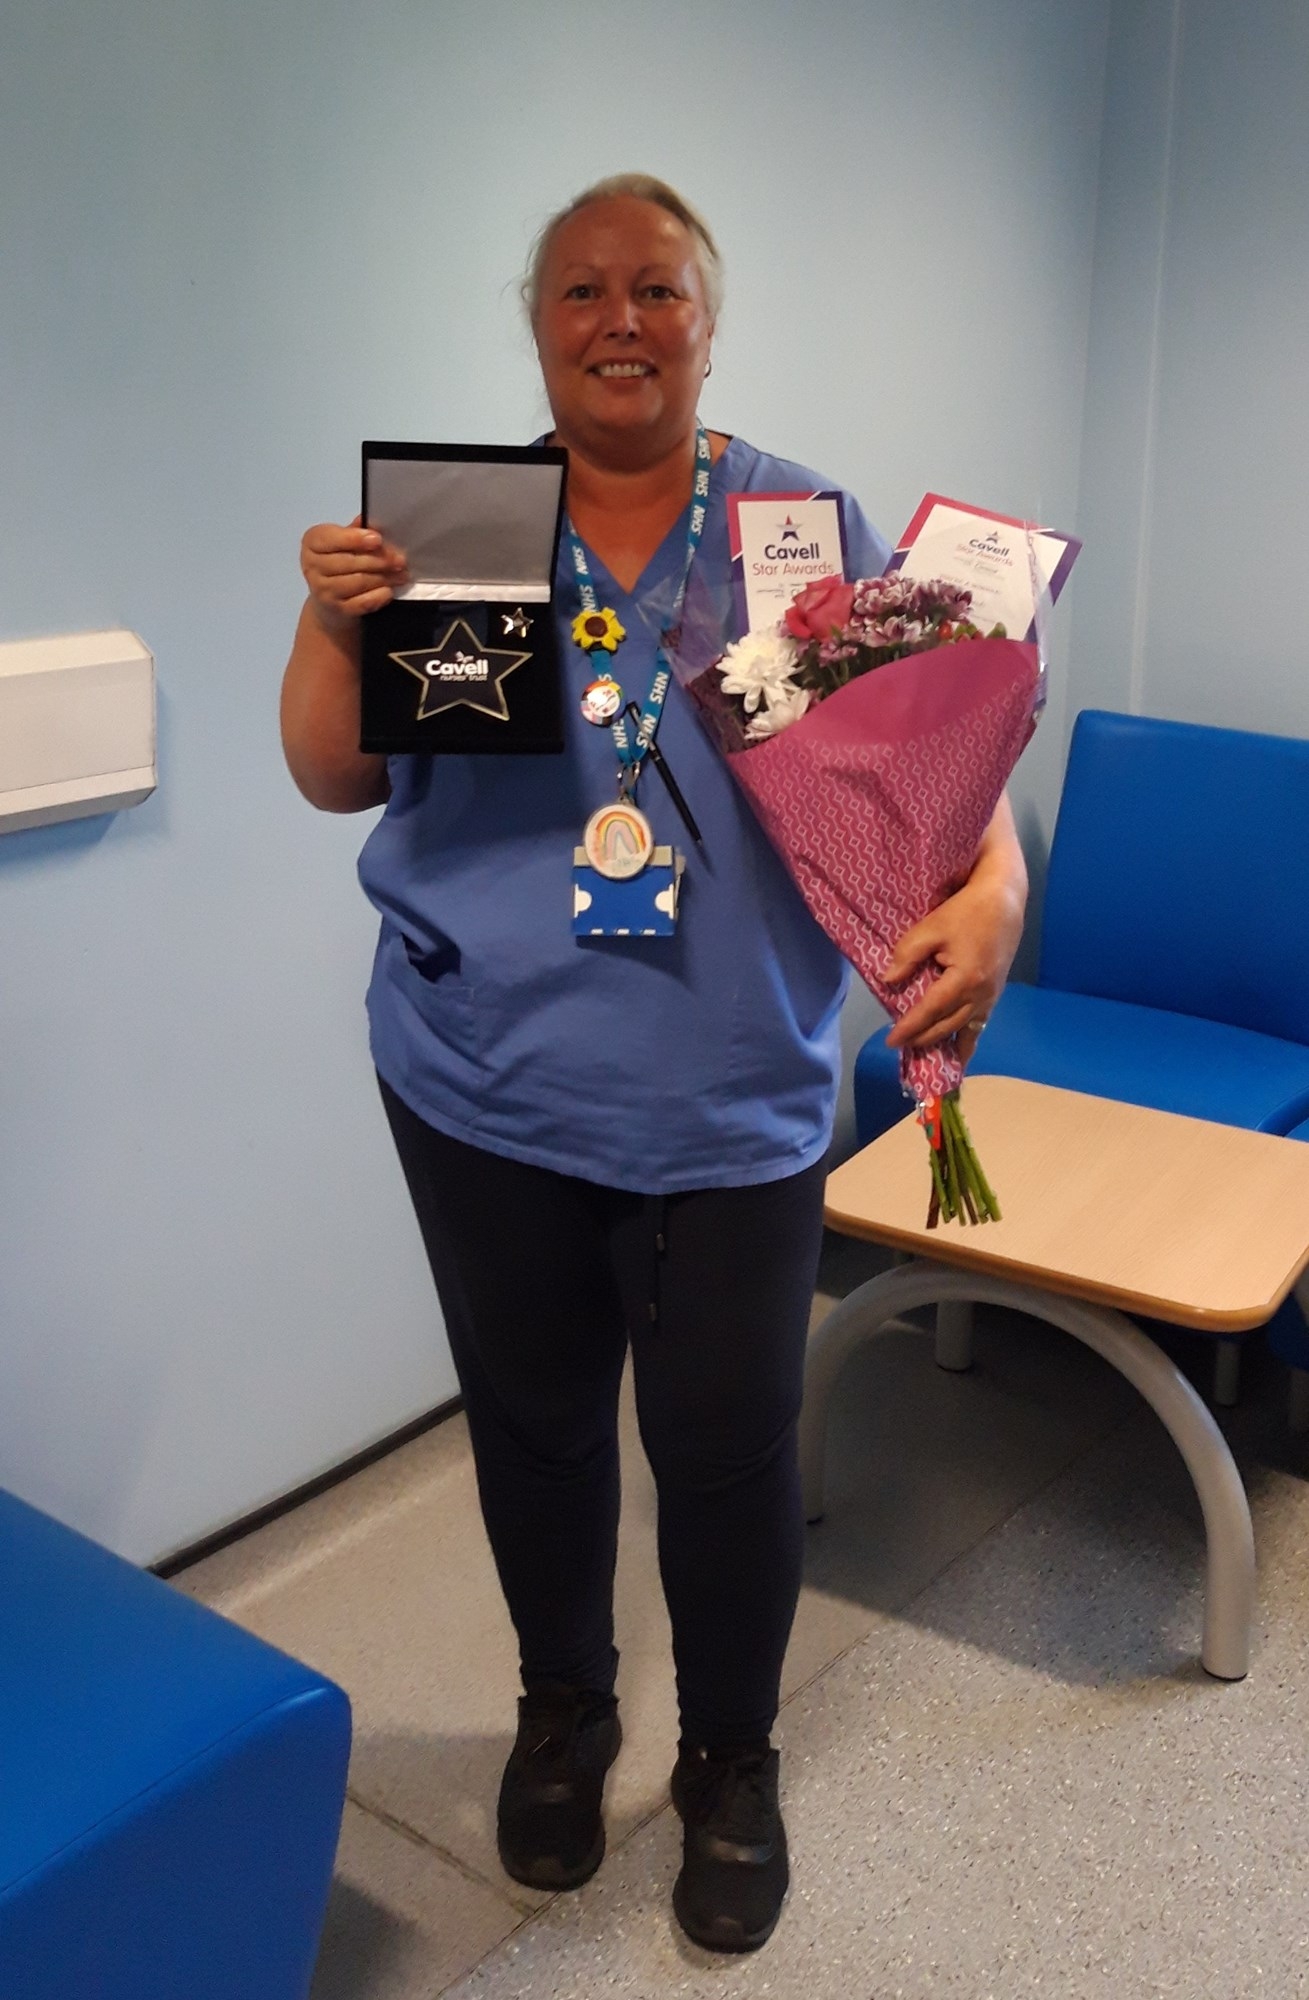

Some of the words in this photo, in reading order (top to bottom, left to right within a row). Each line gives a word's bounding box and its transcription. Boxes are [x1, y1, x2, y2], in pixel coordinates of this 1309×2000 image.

[695, 470, 710, 497] NHS
[690, 504, 706, 536] NHS
[572, 545, 589, 575] NHS
[764, 542, 820, 560] Cavell
[968, 538, 1010, 557] Cavell
[752, 562, 778, 576] Star
[783, 561, 834, 575] Awards
[579, 584, 597, 613] NHS
[426, 659, 488, 676] Cavell
[650, 671, 669, 704] NHS
